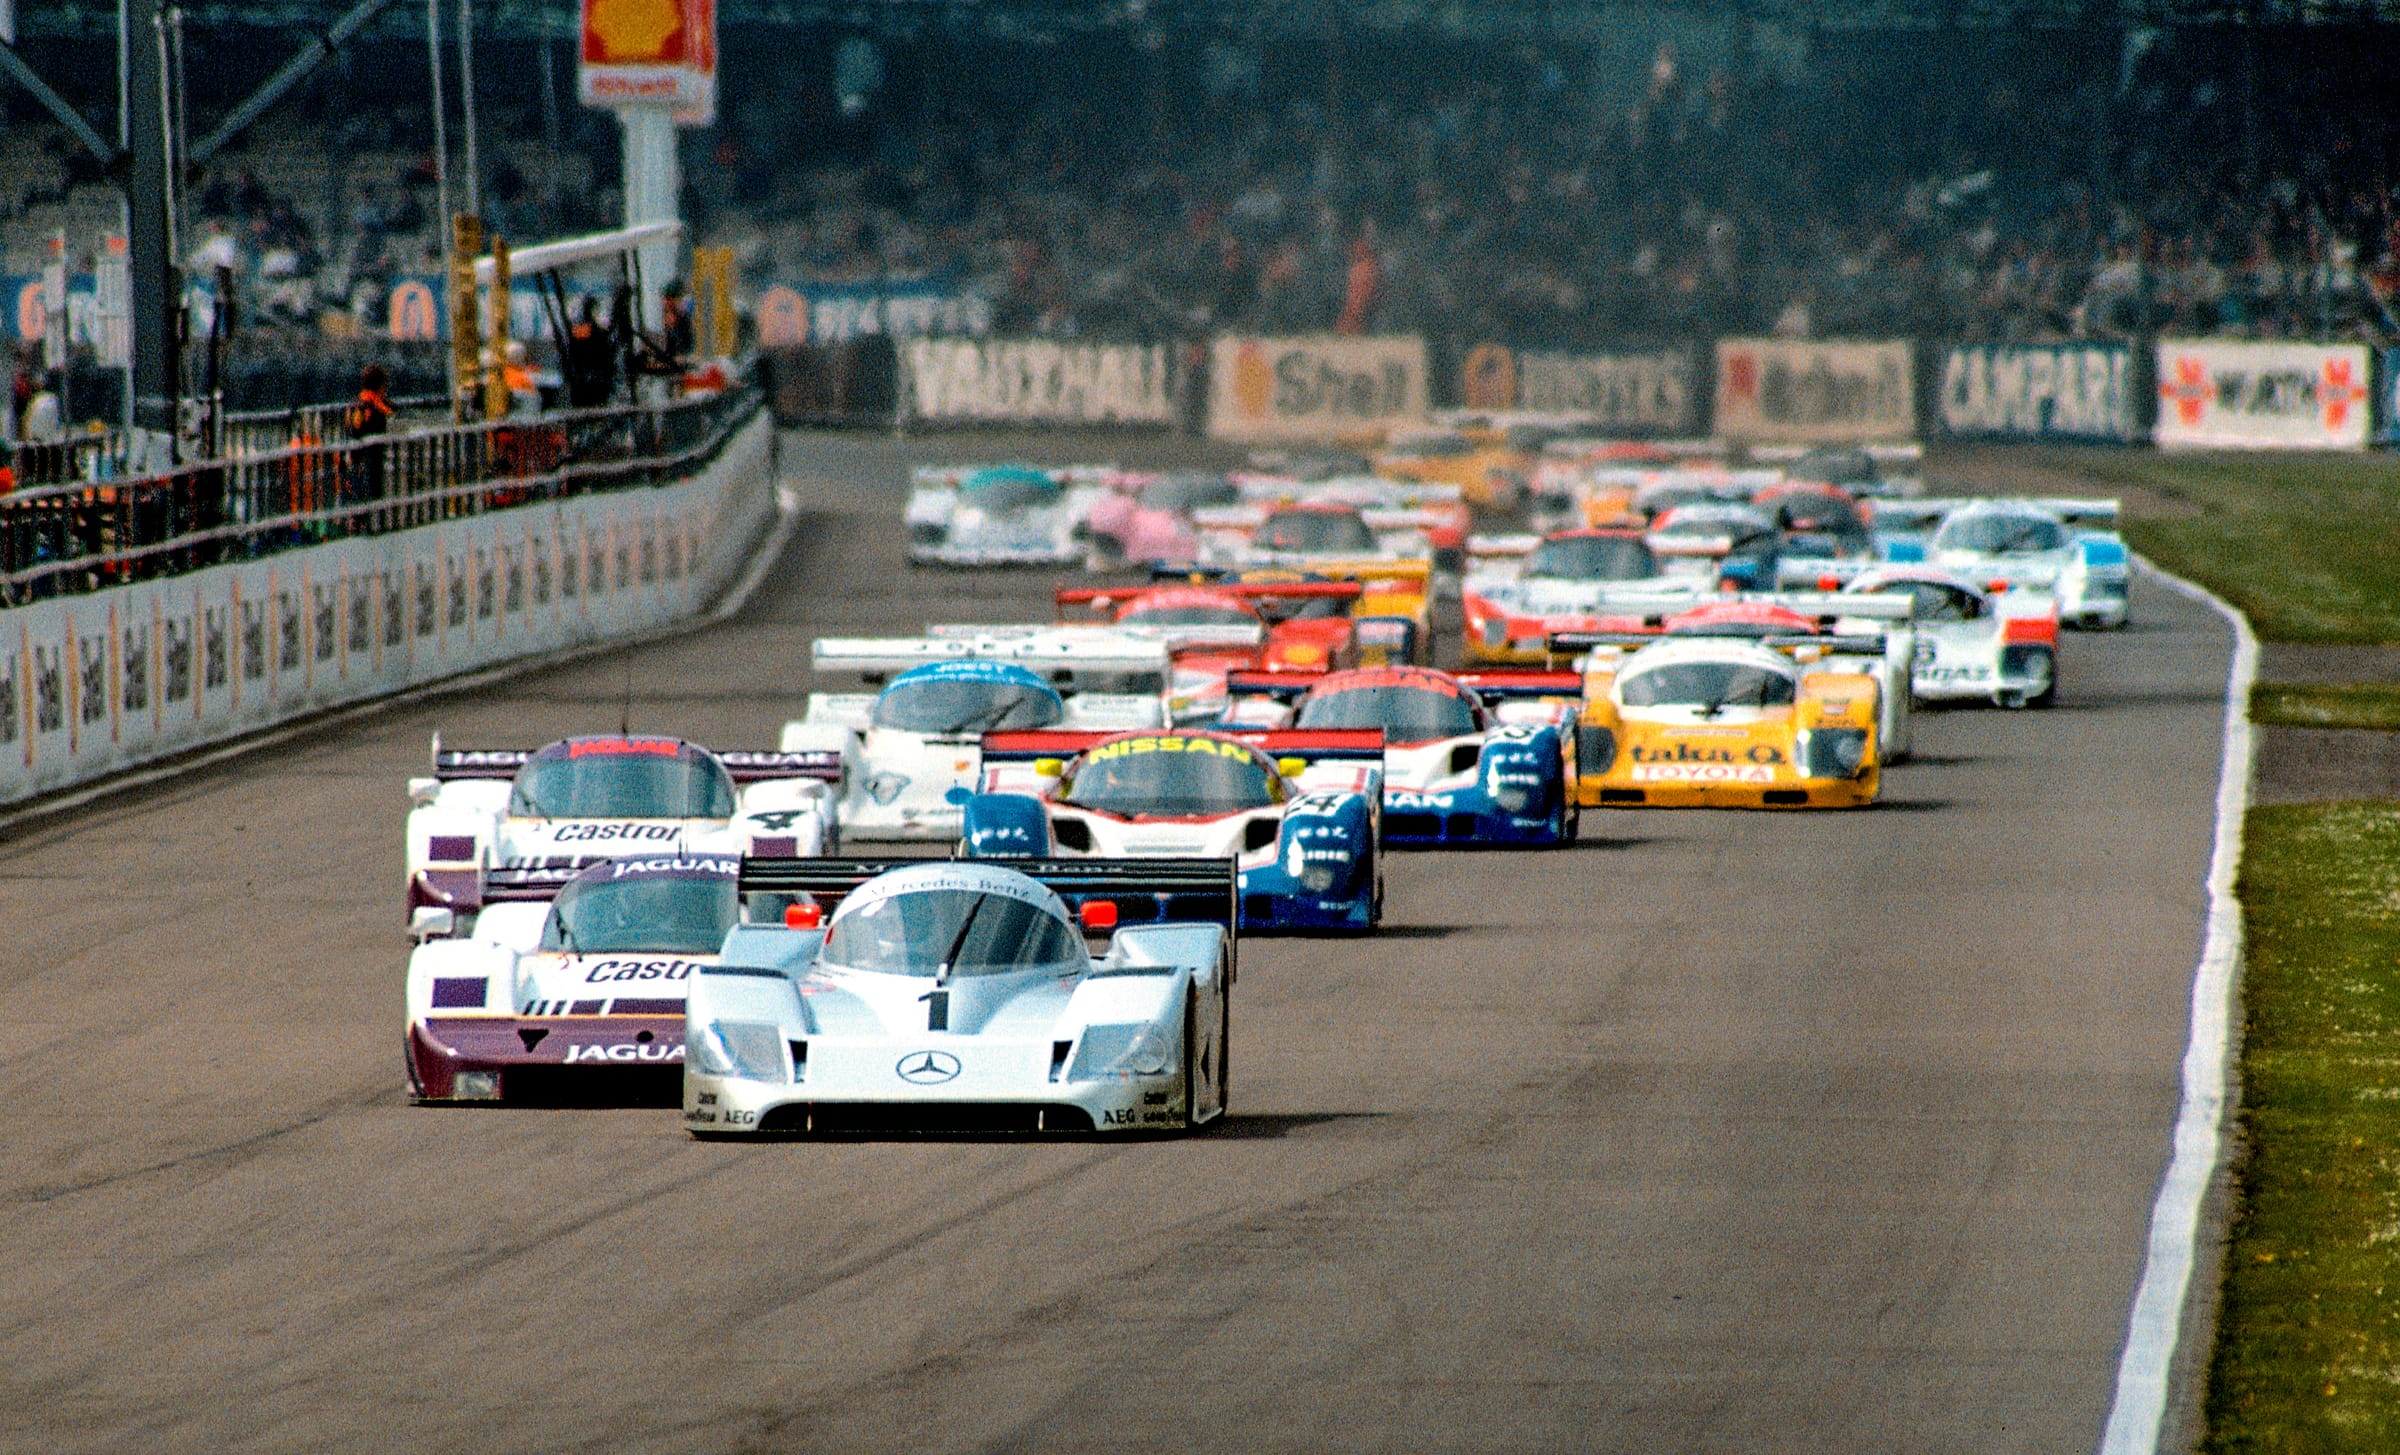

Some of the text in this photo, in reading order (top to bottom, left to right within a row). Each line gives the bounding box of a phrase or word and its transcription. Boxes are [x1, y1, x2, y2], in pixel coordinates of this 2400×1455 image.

[1089, 737, 1251, 765] NISSAN
[1640, 767, 1770, 783] TOYOTA
[747, 809, 806, 831] 4
[516, 868, 578, 881] JAG
[614, 857, 740, 878] JAGUAR
[585, 960, 701, 983] Castr
[918, 991, 949, 1031] 1
[565, 1044, 687, 1064] JAGUA
[724, 1110, 754, 1124] AEG
[1103, 1108, 1135, 1124] AEG
